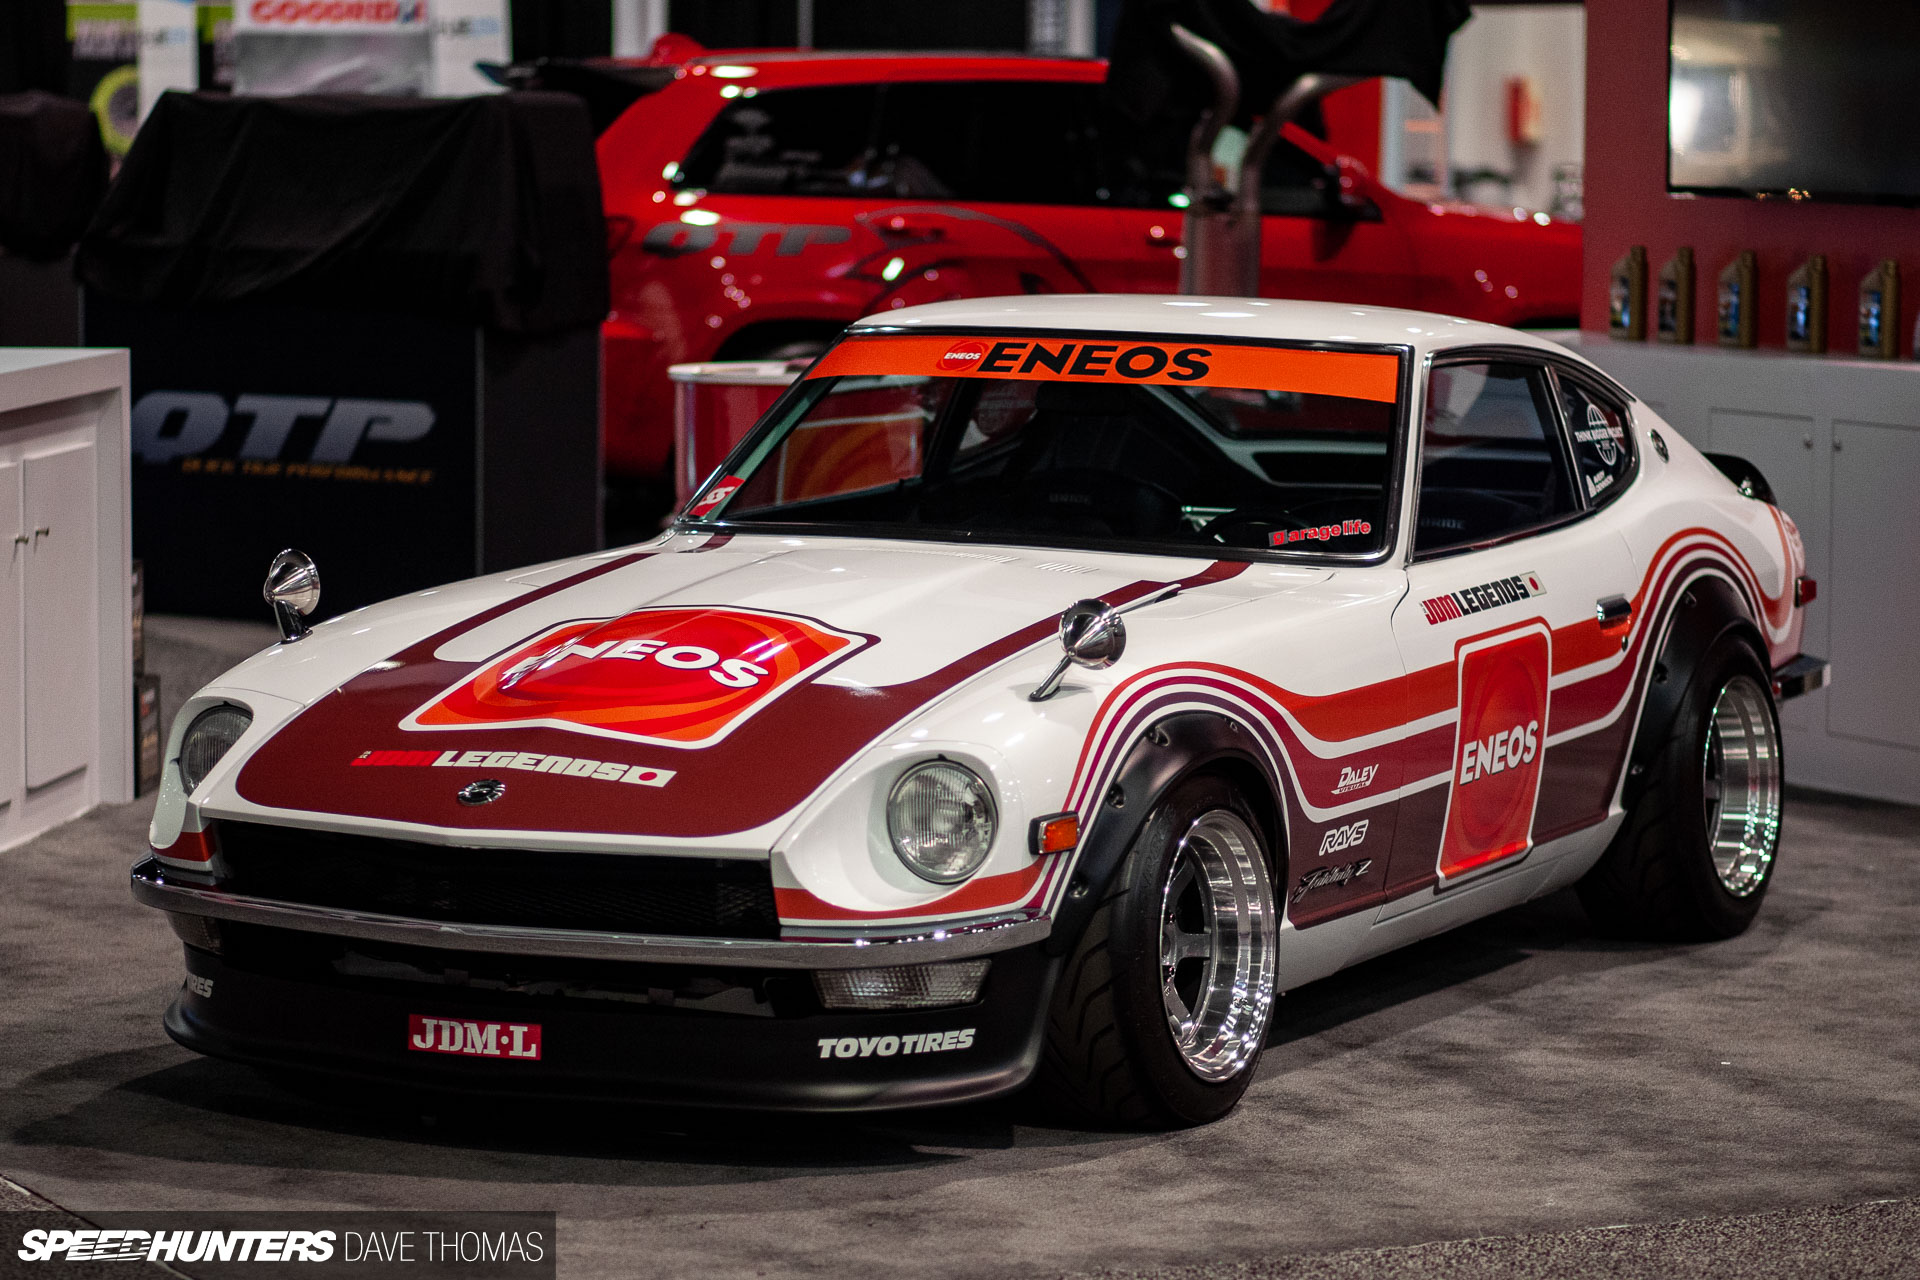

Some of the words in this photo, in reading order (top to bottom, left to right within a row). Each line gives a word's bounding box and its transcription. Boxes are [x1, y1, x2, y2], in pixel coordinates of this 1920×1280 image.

[944, 352, 981, 361] ENEOS
[977, 342, 1213, 381] ENEOS
[1271, 524, 1342, 546] garage
[1342, 519, 1371, 536] life
[1459, 720, 1538, 786] ENEOS
[1337, 763, 1379, 788] DALEY
[1319, 819, 1369, 856] RAYS
[818, 1035, 900, 1058] TOYO
[901, 1028, 976, 1054] TIRES
